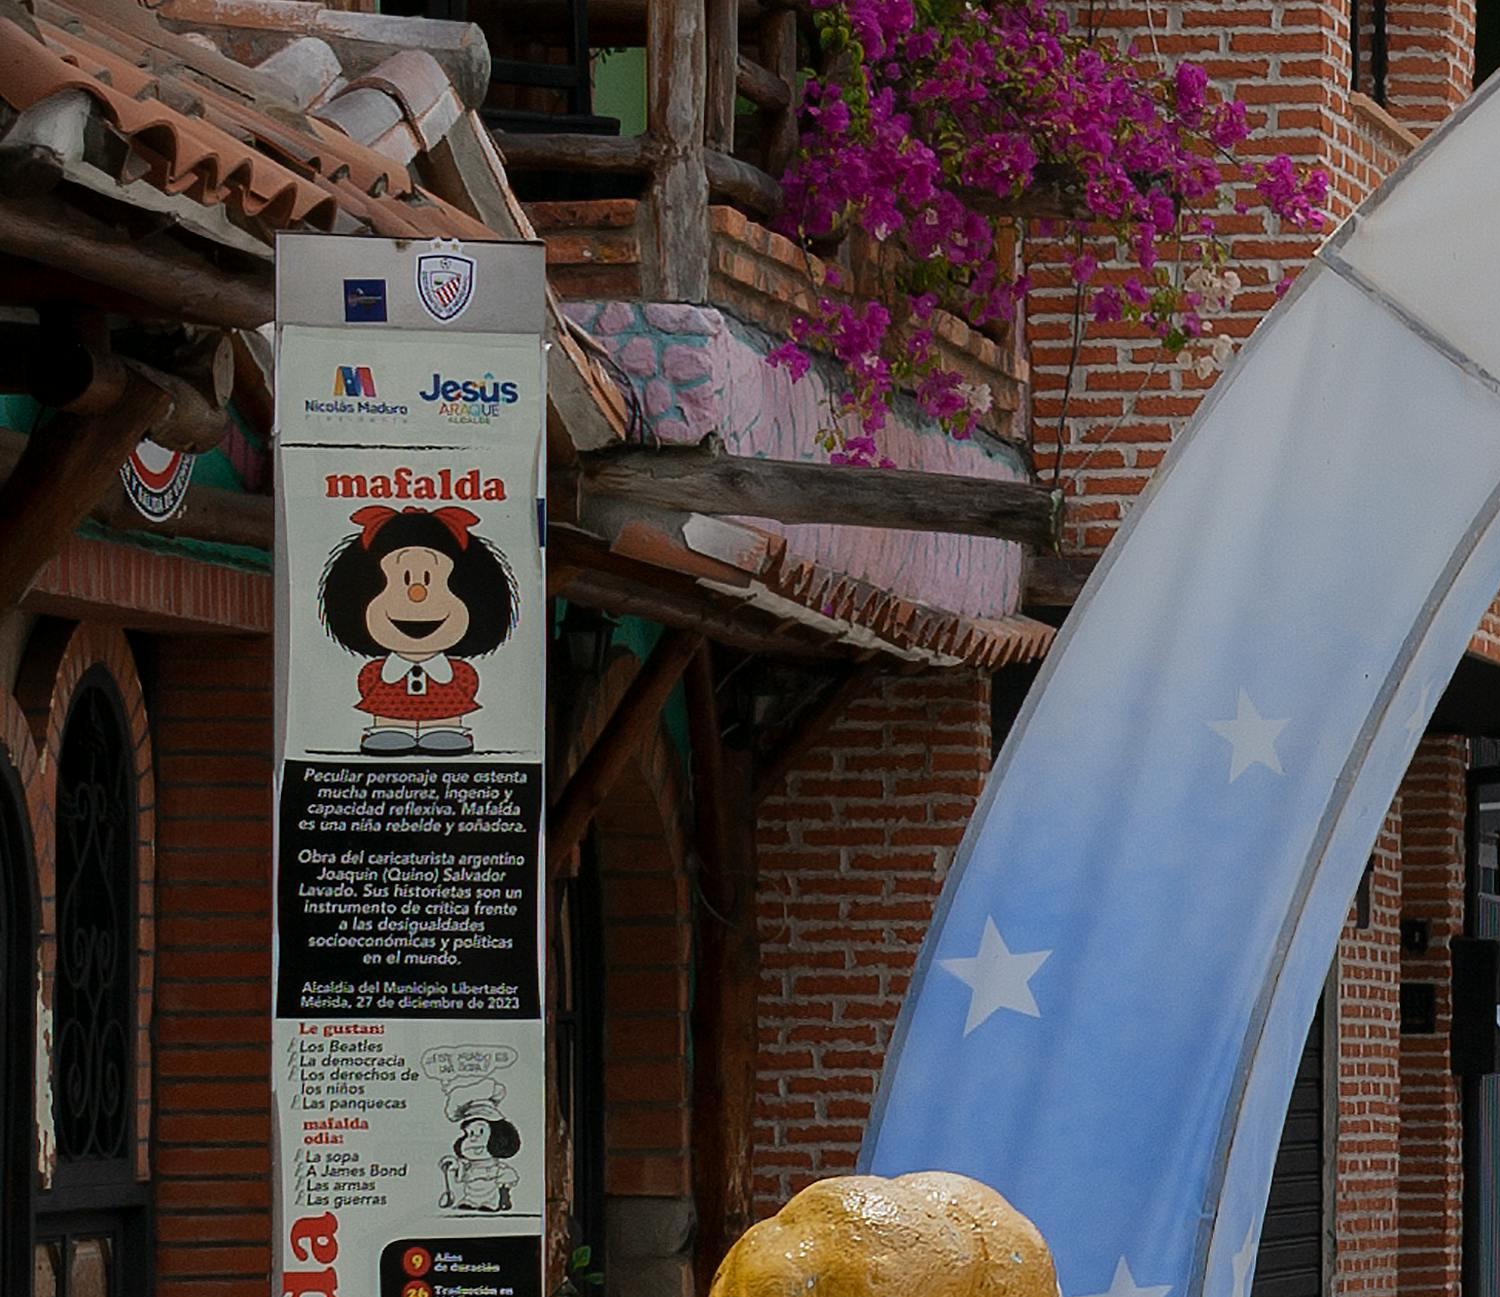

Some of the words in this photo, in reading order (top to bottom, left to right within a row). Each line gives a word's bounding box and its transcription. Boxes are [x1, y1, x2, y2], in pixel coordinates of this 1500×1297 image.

[305, 399, 355, 415] Nicolás
[357, 400, 408, 416] Maduro
[439, 404, 500, 417] ARAQUE
[325, 467, 507, 501] mafalda
[304, 768, 364, 782] Peculiar
[366, 769, 438, 787] personaje
[442, 772, 470, 787] que
[473, 769, 528, 783] ostenta
[317, 785, 367, 799] mucha
[371, 785, 439, 801] madurez,
[444, 785, 500, 803] ingenio
[503, 789, 513, 803] y
[307, 801, 385, 818] capacidad
[389, 800, 456, 816] reflexiva.
[461, 801, 521, 816] Mafalda
[298, 819, 316, 830] es
[320, 820, 347, 832] una
[351, 817, 382, 832] niña
[385, 818, 442, 833] rebelde
[444, 821, 455, 836] y
[458, 818, 527, 833] soñadora.
[298, 849, 337, 864] Obra
[341, 850, 365, 864] del
[368, 851, 455, 865] caricaturista
[459, 852, 525, 869] argentino
[383, 867, 439, 884] (Quino)
[443, 867, 507, 882] Salvador
[298, 883, 358, 897] Lavado.
[363, 883, 389, 897] Sus
[394, 884, 472, 899] historietas
[476, 888, 501, 899] son
[505, 888, 523, 899] un
[304, 900, 397, 914] instrumento
[401, 900, 421, 914] de
[425, 901, 470, 915] crítica
[475, 901, 518, 916] frente
[339, 920, 348, 931] a
[353, 916, 373, 931] las
[378, 916, 485, 935] desigualdades
[308, 933, 436, 948] socioeconómicas
[440, 937, 450, 952] y
[453, 934, 513, 952] políticas
[363, 953, 382, 964] en
[386, 950, 401, 964] el
[404, 950, 462, 965] mundo.
[302, 981, 355, 994] Alcaldía
[358, 981, 380, 994] del
[384, 982, 448, 996] Municipio
[451, 982, 519, 995] Libertador
[300, 995, 352, 1009] Mérida,
[356, 995, 373, 1008] 27
[376, 996, 395, 1009] de
[398, 995, 464, 1009] diciembre
[467, 996, 485, 1009] de
[487, 996, 520, 1009] 2023
[299, 1022, 318, 1035] Le
[300, 1040, 324, 1053] Los
[329, 1039, 383, 1053] Beatles
[300, 1055, 316, 1067] La
[321, 1054, 405, 1067] democracia
[300, 1068, 325, 1081] Los
[329, 1067, 396, 1081] derechos
[400, 1067, 420, 1081] de
[301, 1083, 322, 1095] los
[327, 1083, 365, 1095] niños
[302, 1097, 325, 1109] Las
[329, 1099, 407, 1113] panquecas
[303, 1118, 369, 1130] mafalda
[303, 1132, 344, 1145] odia:
[306, 1150, 321, 1163] La
[326, 1153, 359, 1166] sopa
[306, 1164, 317, 1177] A
[321, 1164, 366, 1177] James
[370, 1163, 407, 1177] Bond
[306, 1179, 329, 1192] Las
[333, 1182, 376, 1192] armas
[306, 1193, 329, 1206] Las
[334, 1195, 388, 1210] guerras
[412, 1255, 424, 1270] 9
